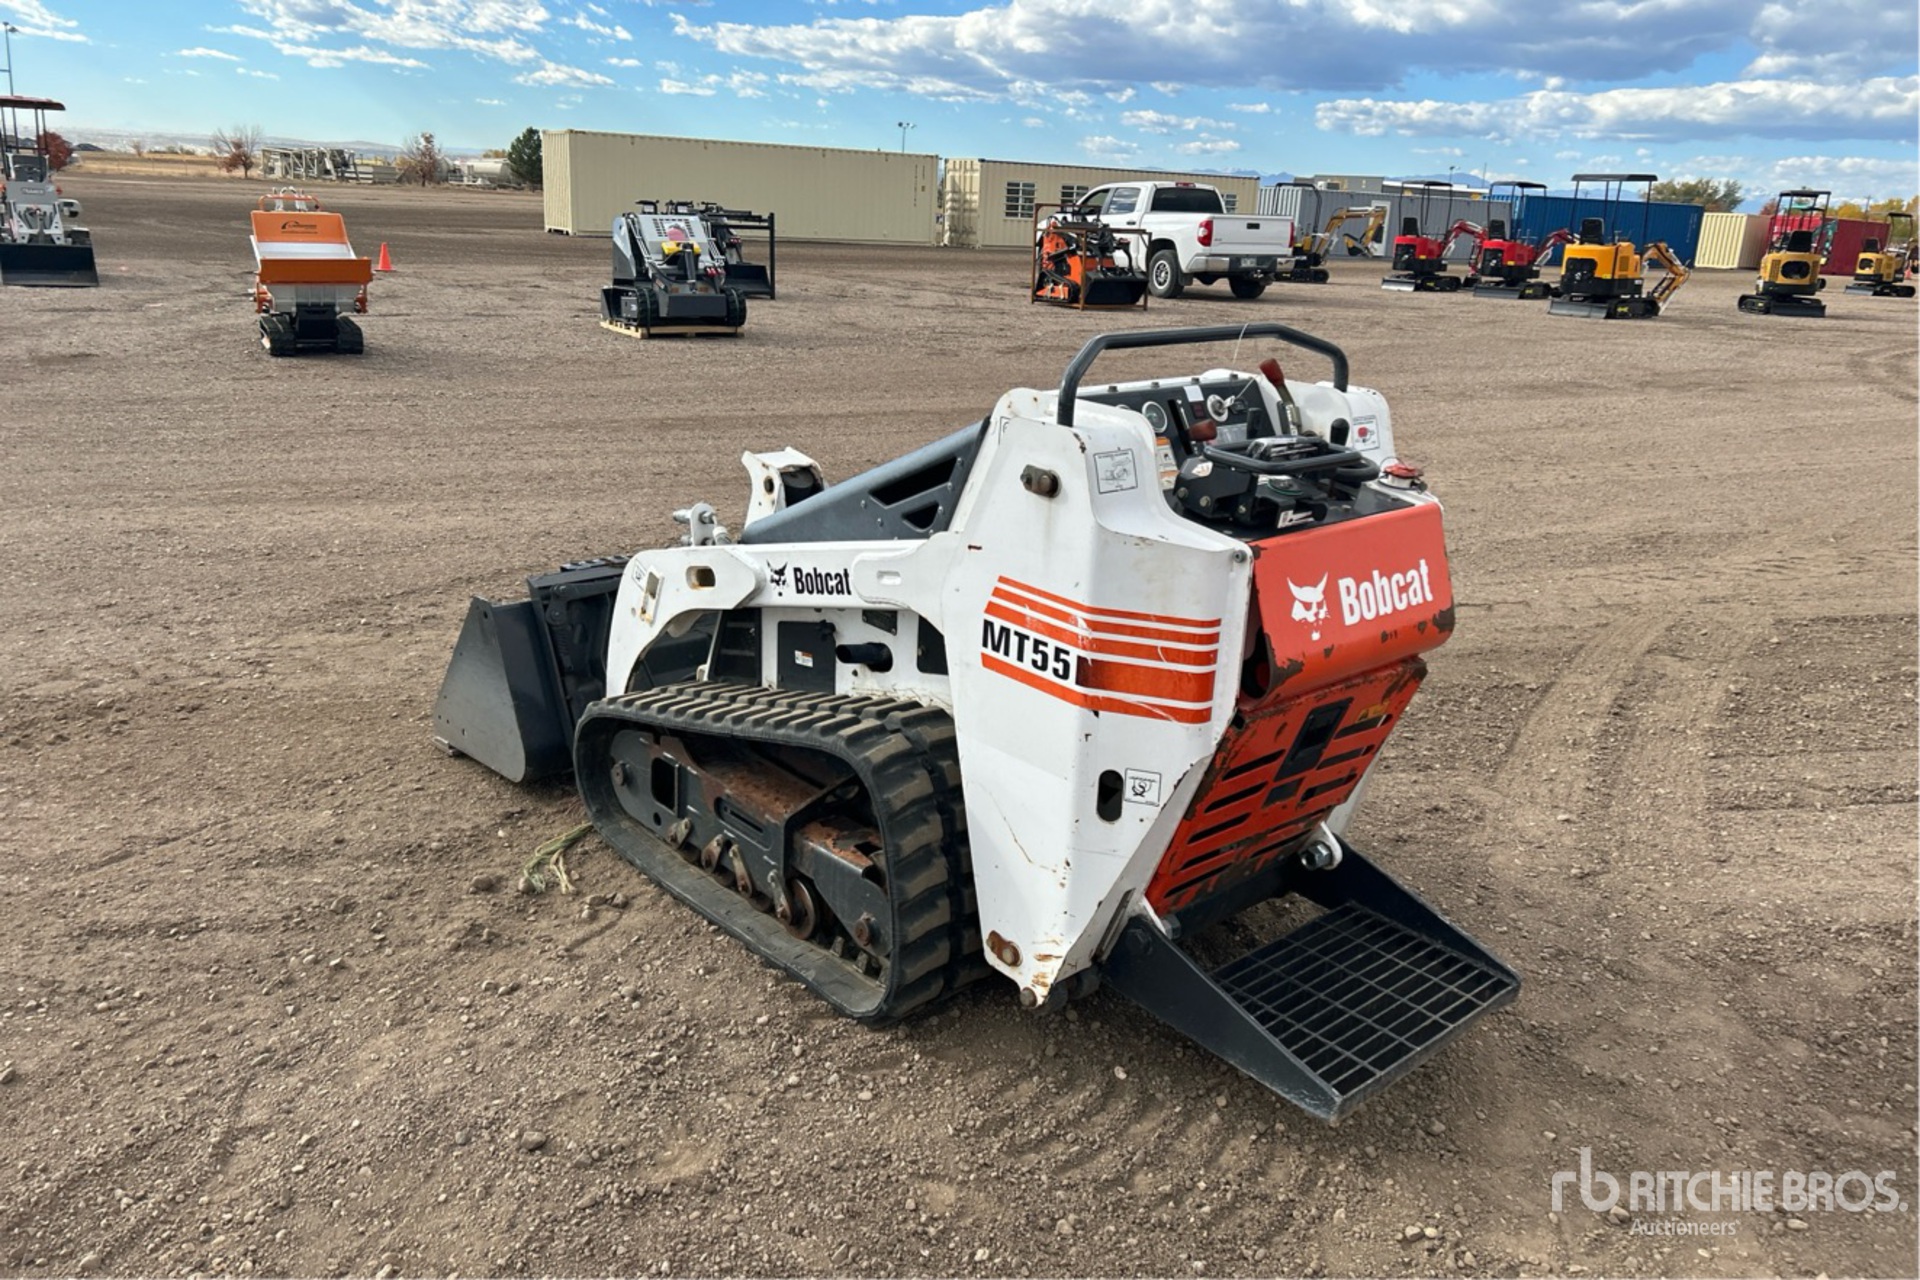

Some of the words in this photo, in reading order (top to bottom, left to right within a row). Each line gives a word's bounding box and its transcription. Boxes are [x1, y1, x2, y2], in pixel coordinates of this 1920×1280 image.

[793, 567, 852, 596] Bobcat
[1337, 558, 1434, 626] Bobcat
[981, 618, 1071, 681] MT55
